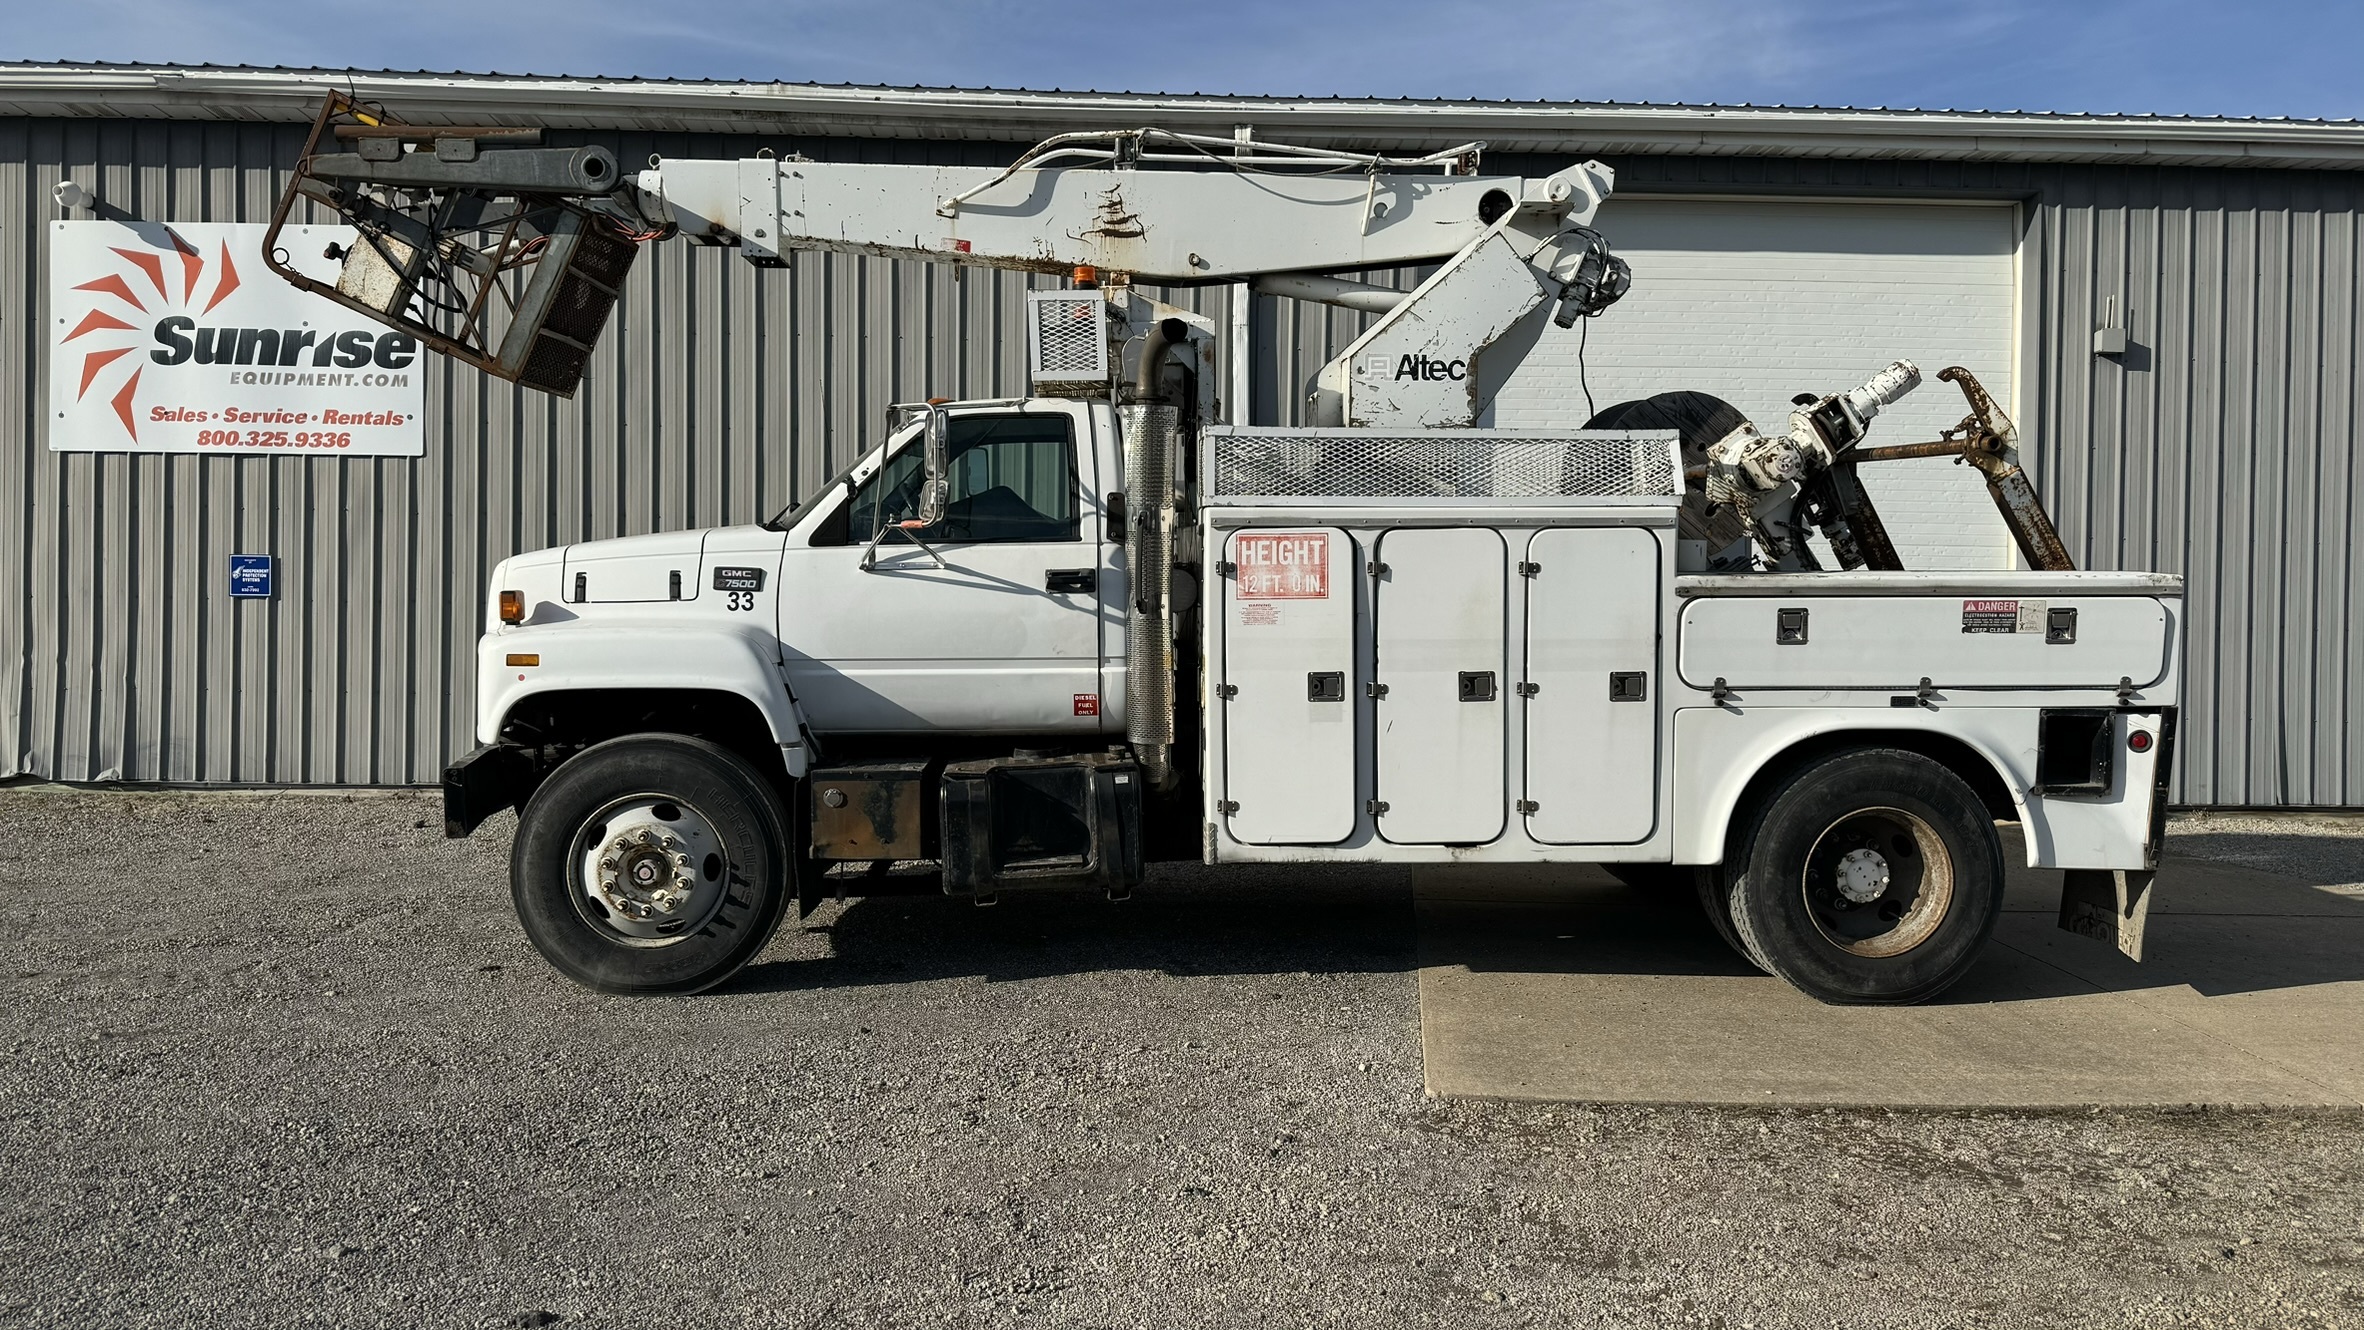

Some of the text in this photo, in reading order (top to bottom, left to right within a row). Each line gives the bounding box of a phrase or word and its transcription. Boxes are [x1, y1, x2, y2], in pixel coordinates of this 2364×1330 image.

[150, 315, 417, 370] Sunrise
[1394, 353, 1466, 381] Altec
[230, 371, 409, 388] EQUIPMENT.COM
[150, 405, 404, 426] Sales Service Rentals
[197, 430, 351, 448] 800.325.9336
[1241, 540, 1324, 565] HEIGHT
[1242, 575, 1258, 593] 12
[1262, 575, 1284, 593] FT.
[1305, 574, 1324, 592] IN.
[726, 591, 754, 612] 33
[1978, 601, 2016, 611] DANGER
